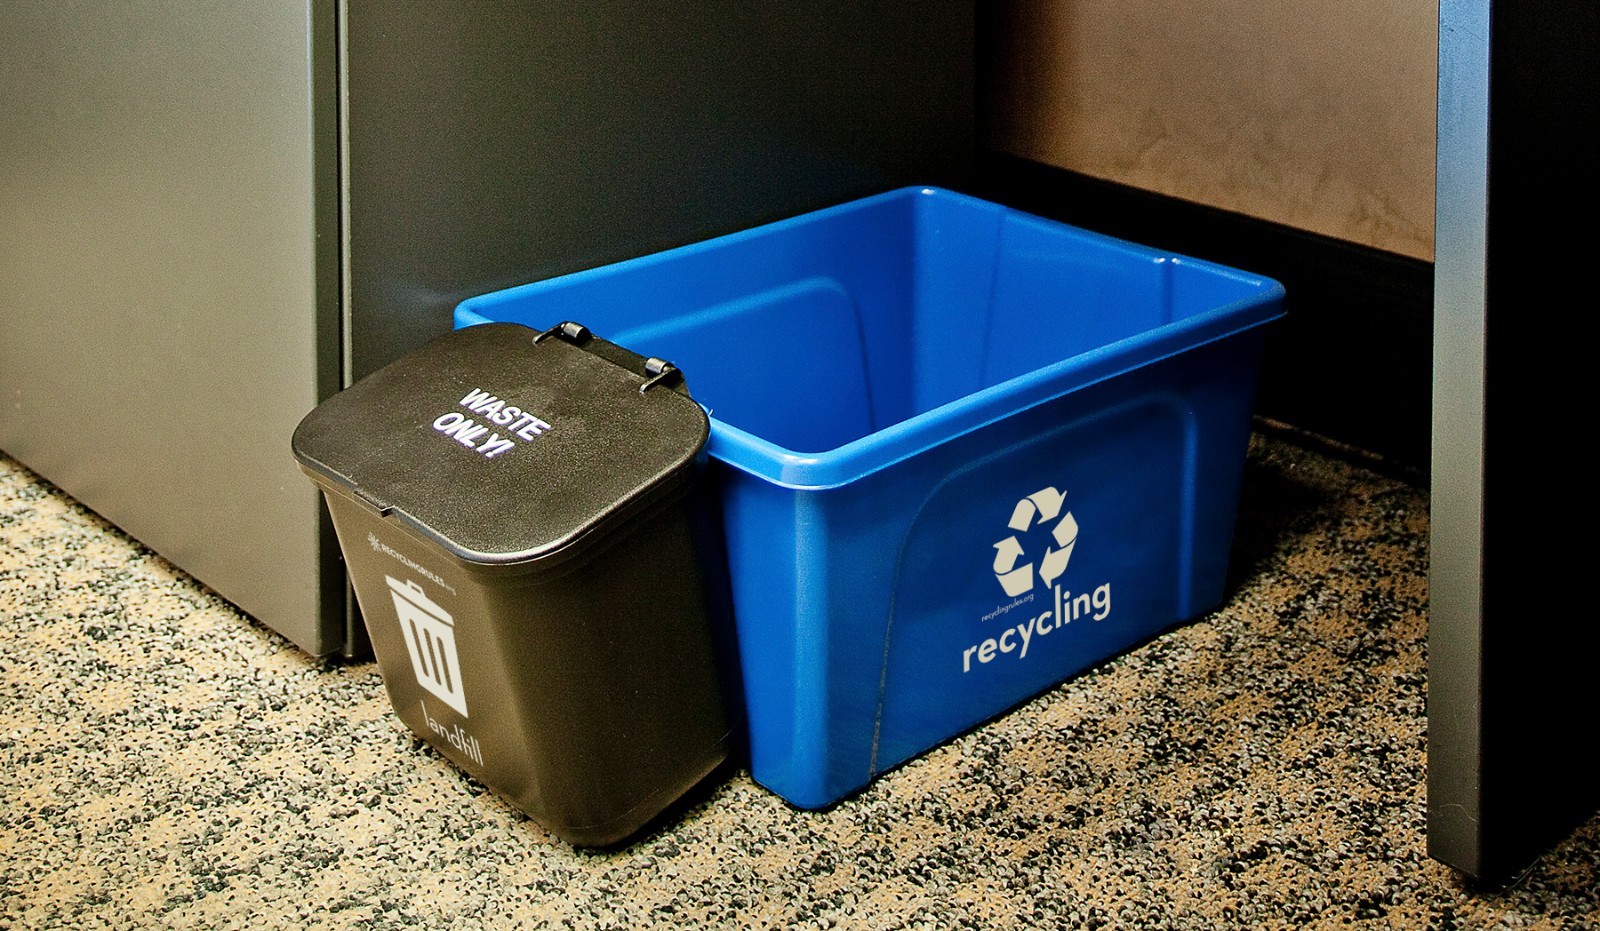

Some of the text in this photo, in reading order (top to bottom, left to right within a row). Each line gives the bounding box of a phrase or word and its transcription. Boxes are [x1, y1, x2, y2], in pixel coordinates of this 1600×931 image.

[432, 412, 515, 458] ONLY!
[459, 387, 551, 441] WASTE
[963, 582, 1111, 673] recycling
[981, 593, 1034, 622] recyclingrules.org
[421, 700, 484, 767] landfill
